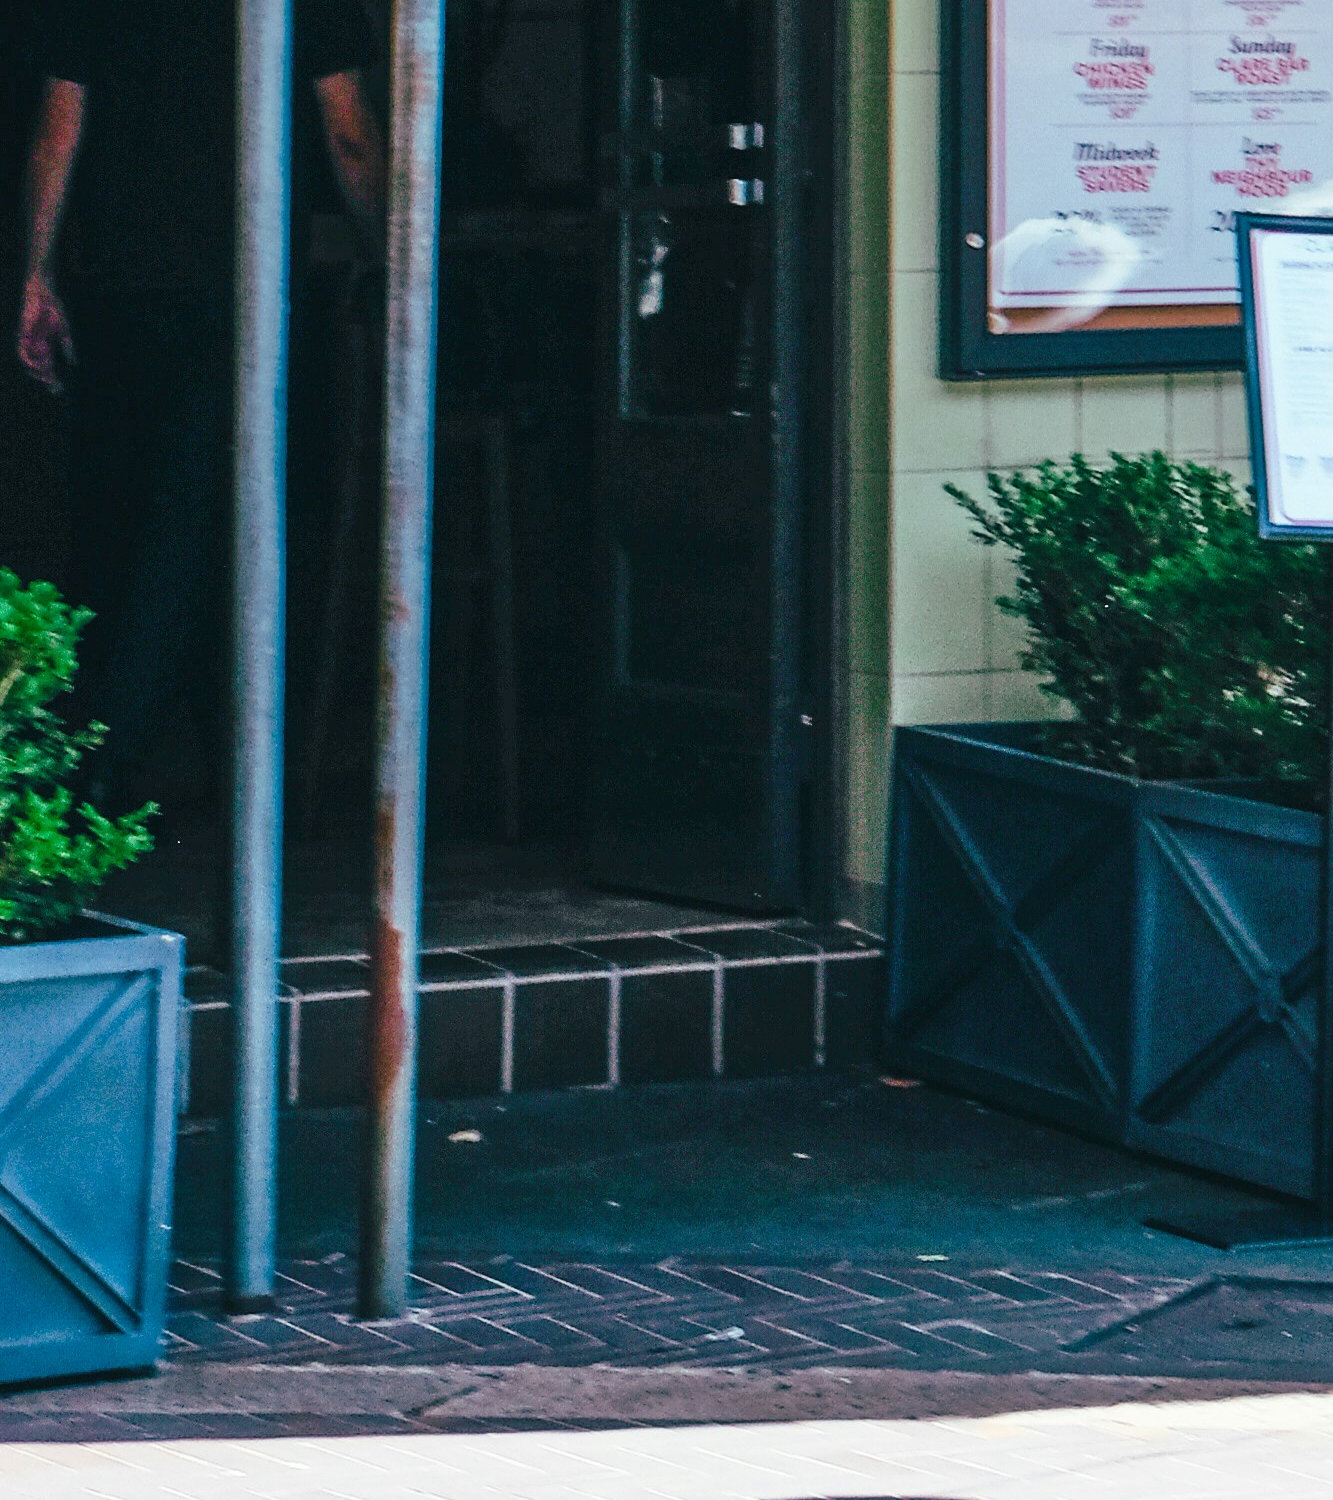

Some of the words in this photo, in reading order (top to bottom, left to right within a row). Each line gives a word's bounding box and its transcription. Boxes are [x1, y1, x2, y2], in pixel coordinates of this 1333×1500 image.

[1089, 37, 1149, 59] Friday
[1228, 34, 1297, 56] Sunday
[1074, 141, 1159, 162] Midweek
